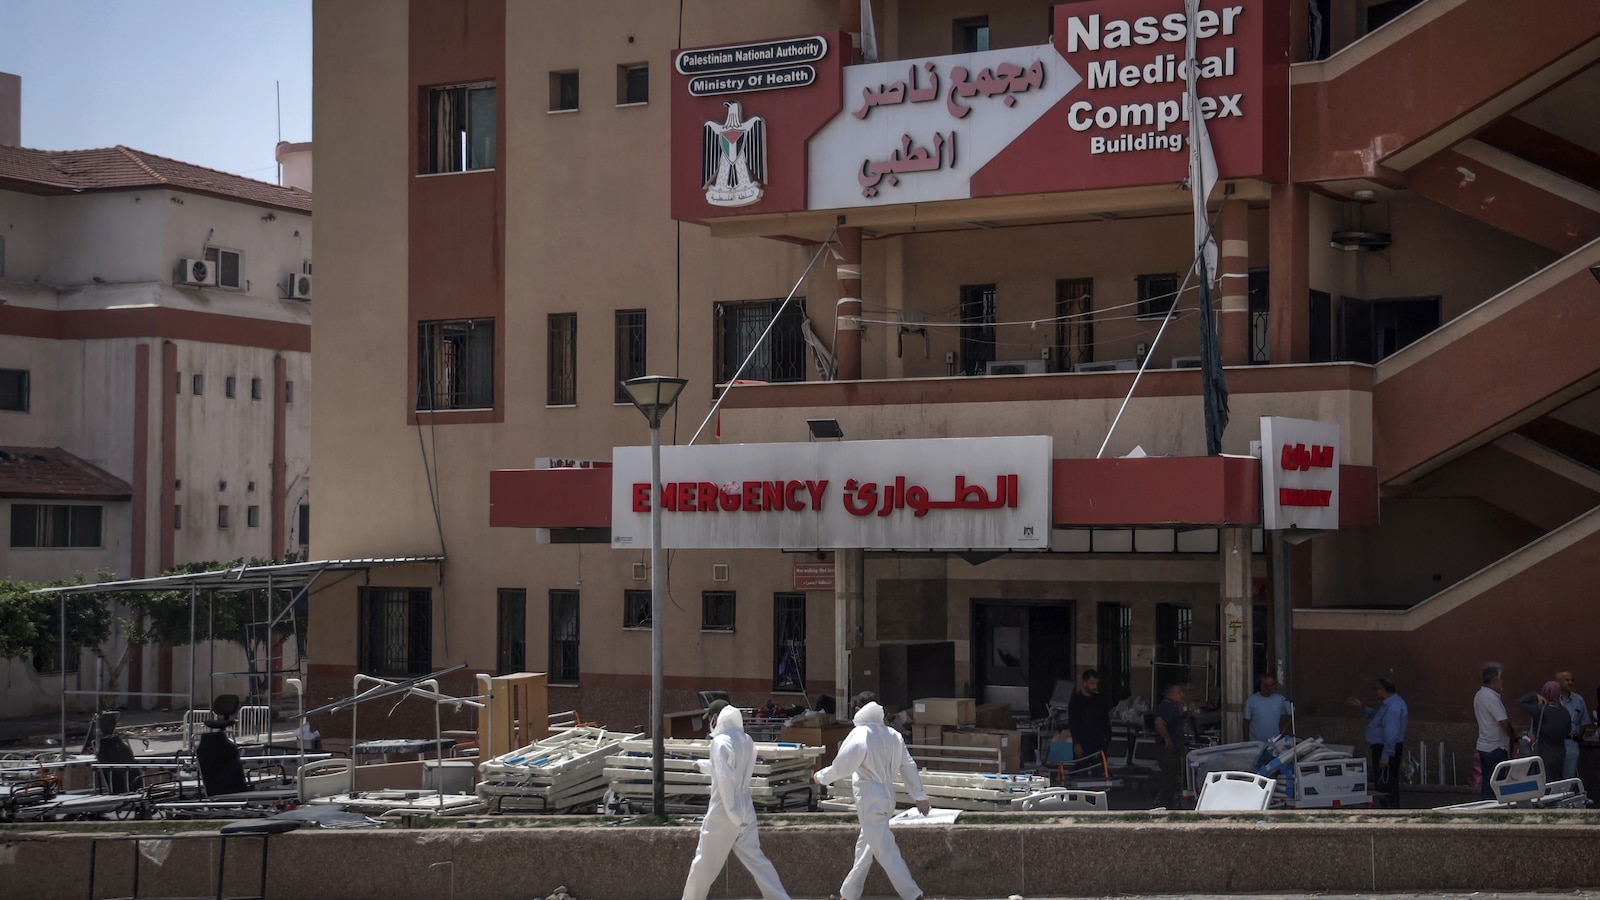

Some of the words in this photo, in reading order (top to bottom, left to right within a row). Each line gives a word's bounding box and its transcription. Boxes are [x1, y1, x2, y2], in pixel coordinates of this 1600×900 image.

[1067, 5, 1243, 52] Nasser
[683, 49, 733, 66] Palestinian
[735, 46, 774, 63] National
[776, 42, 819, 59] Authority
[693, 77, 744, 93] Ministry
[748, 75, 763, 87] Of
[766, 70, 809, 84] Health
[851, 61, 939, 120] ناصر
[946, 58, 1044, 119] مجمع
[1067, 91, 1243, 132] Complex
[1090, 131, 1183, 155] Building
[857, 130, 956, 199] الطبي
[632, 479, 829, 512] EMERGENCY
[843, 474, 1018, 517] الطوارئ
